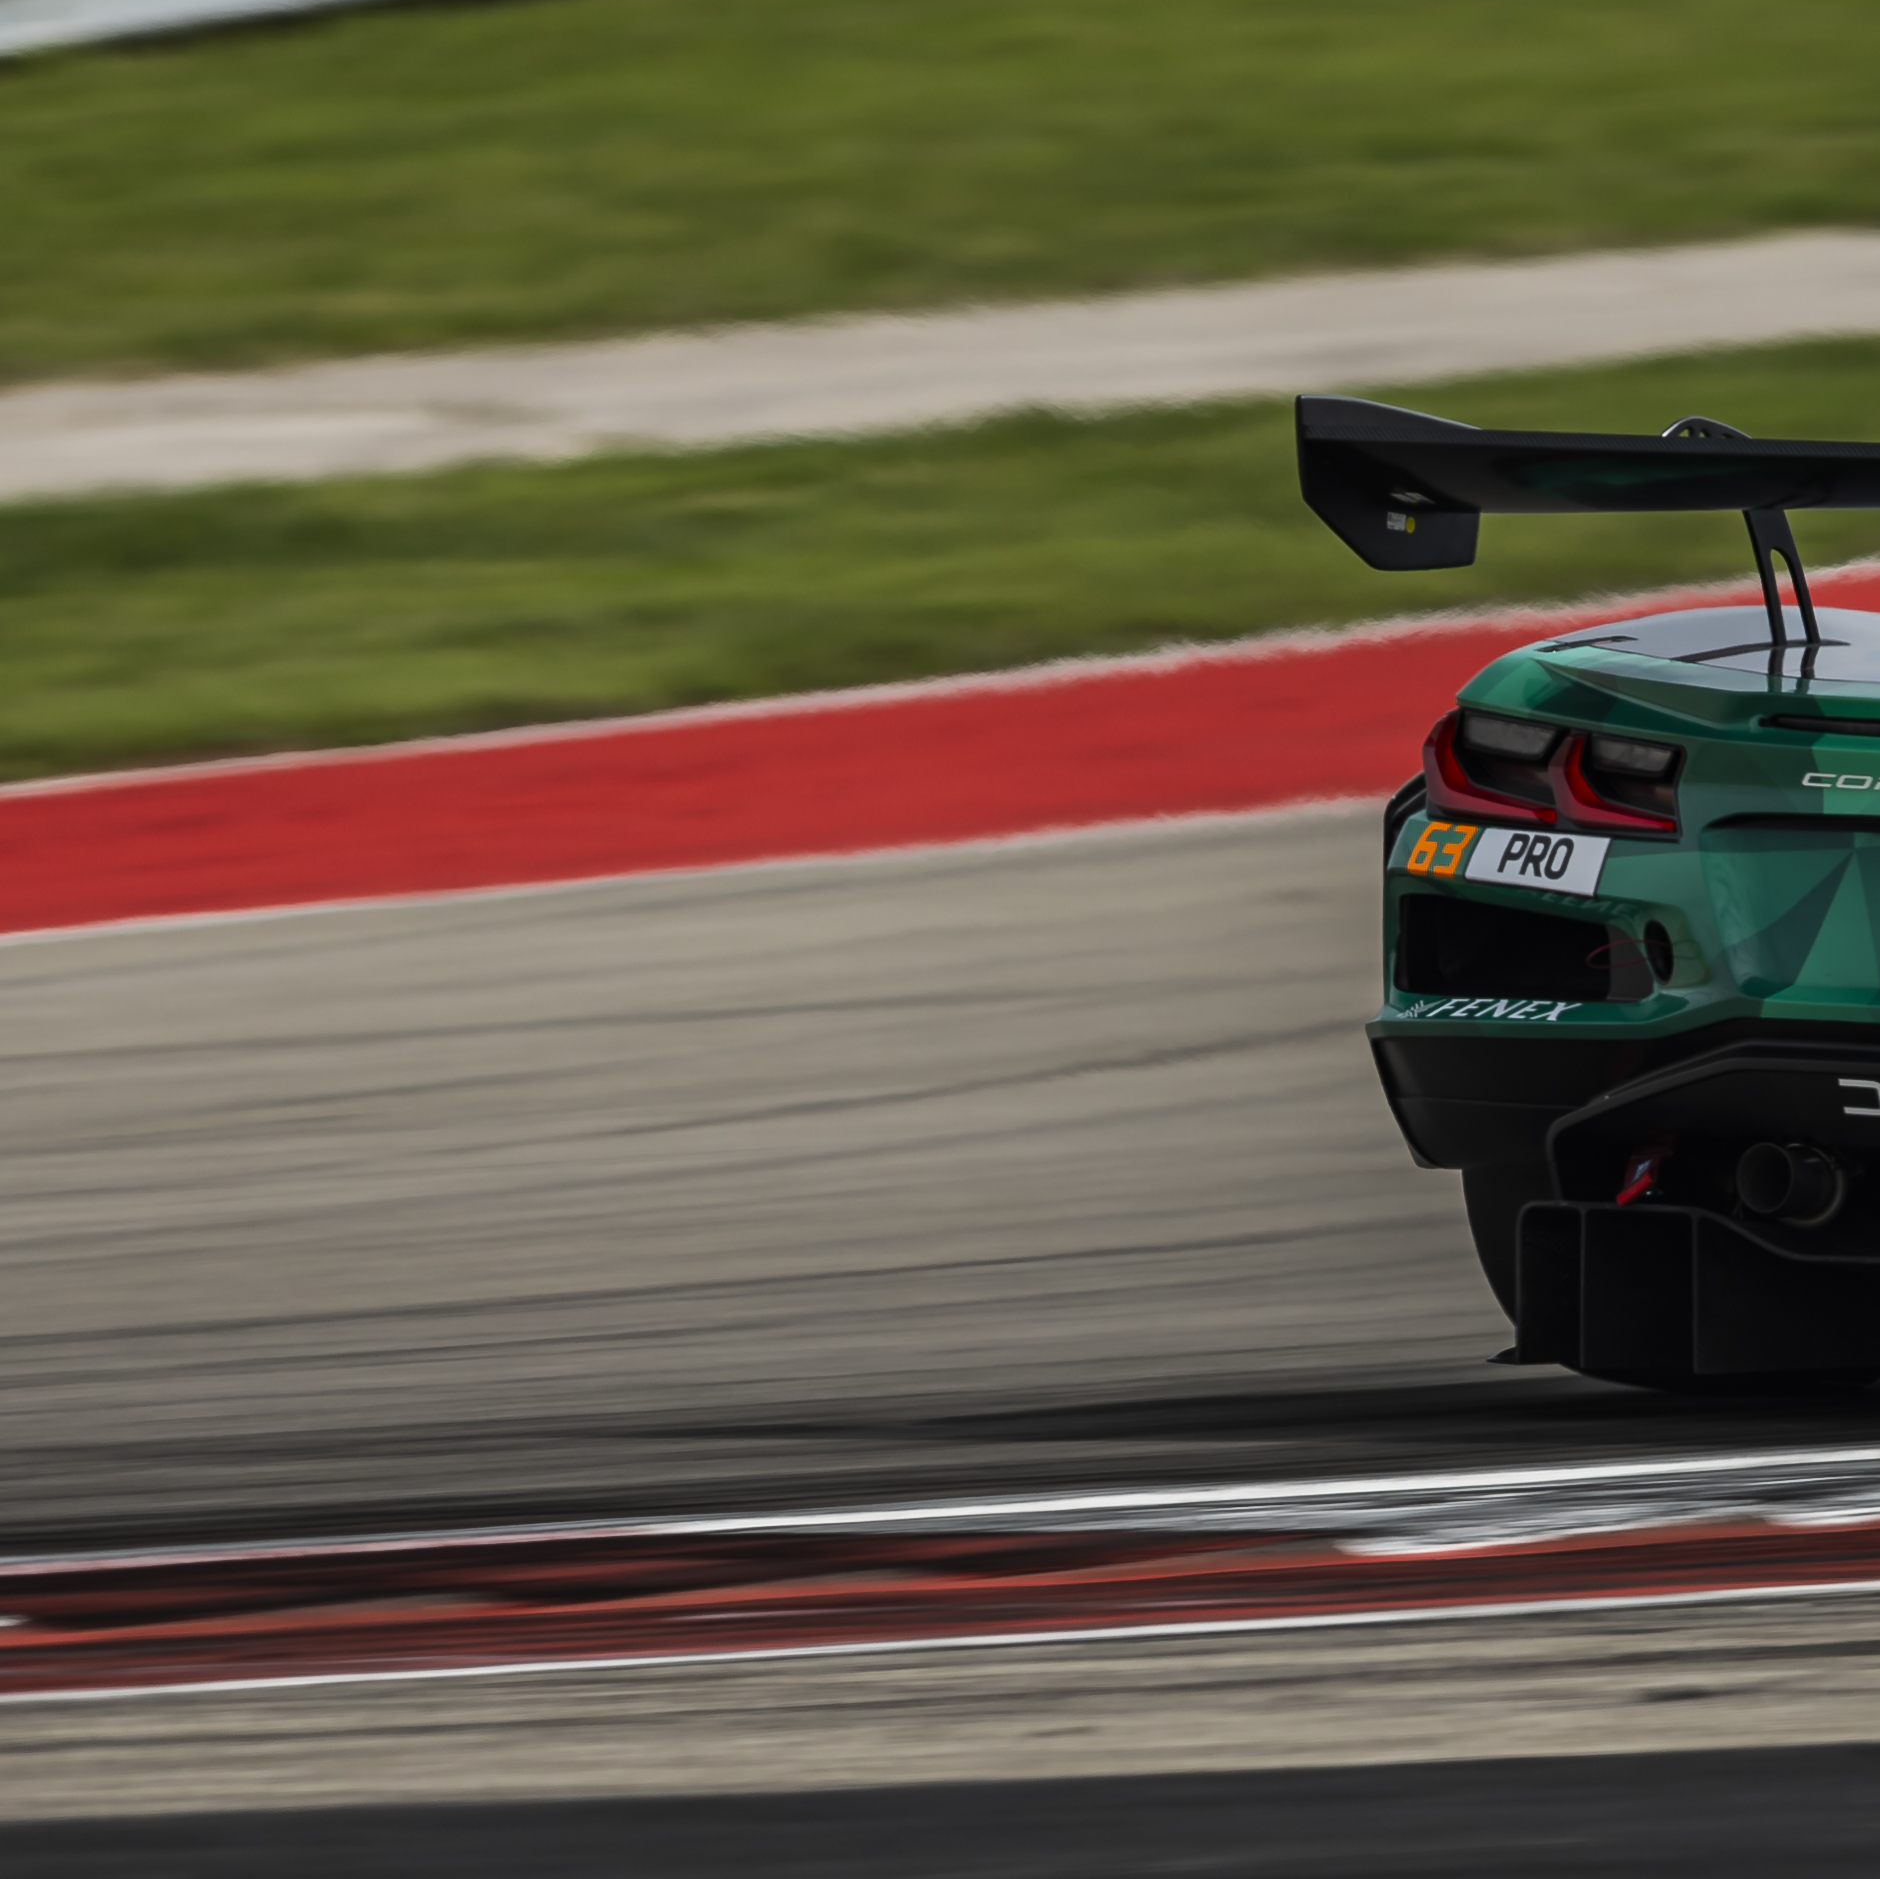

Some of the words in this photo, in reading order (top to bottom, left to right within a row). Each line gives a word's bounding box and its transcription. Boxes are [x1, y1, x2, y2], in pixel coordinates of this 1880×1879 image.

[1406, 821, 1477, 877] 63
[1497, 832, 1574, 880] PRO
[1426, 998, 1583, 1021] FENEX
